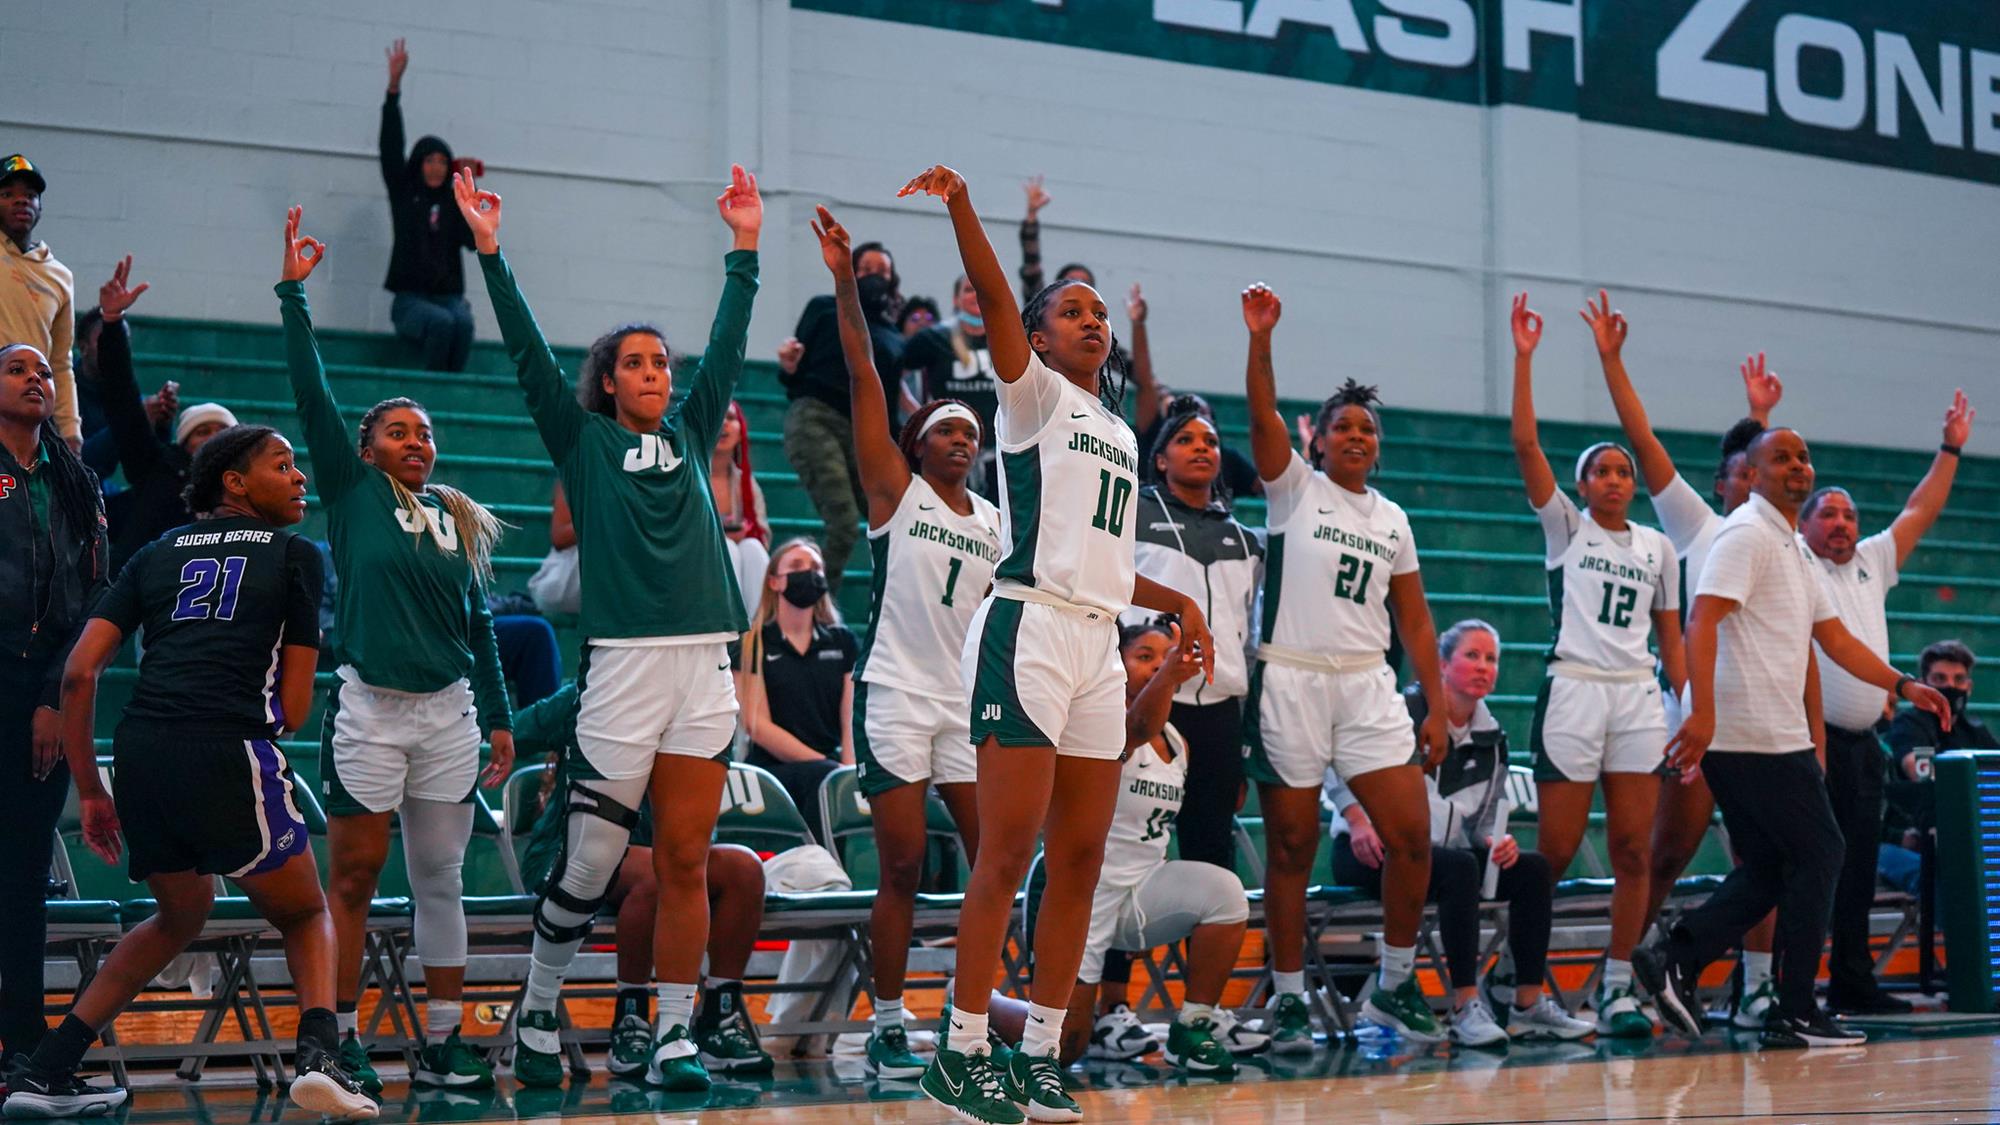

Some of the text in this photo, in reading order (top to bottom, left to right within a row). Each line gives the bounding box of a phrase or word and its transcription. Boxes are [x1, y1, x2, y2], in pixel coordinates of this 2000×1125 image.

[1030, 0, 1583, 87] ASH
[623, 433, 683, 473] JU
[1068, 431, 1138, 476] JACKSONV
[1091, 468, 1132, 538] 10
[174, 529, 274, 547] SUGAR BEARS
[908, 520, 998, 564] JACKSONVIL
[171, 556, 248, 621] 21
[941, 556, 963, 608] 1
[1334, 552, 1374, 606] 21
[1579, 554, 1658, 586] JACKSONVI
[1597, 581, 1638, 628] 12
[981, 703, 1002, 721] JU
[1129, 778, 1184, 802] JACKSON
